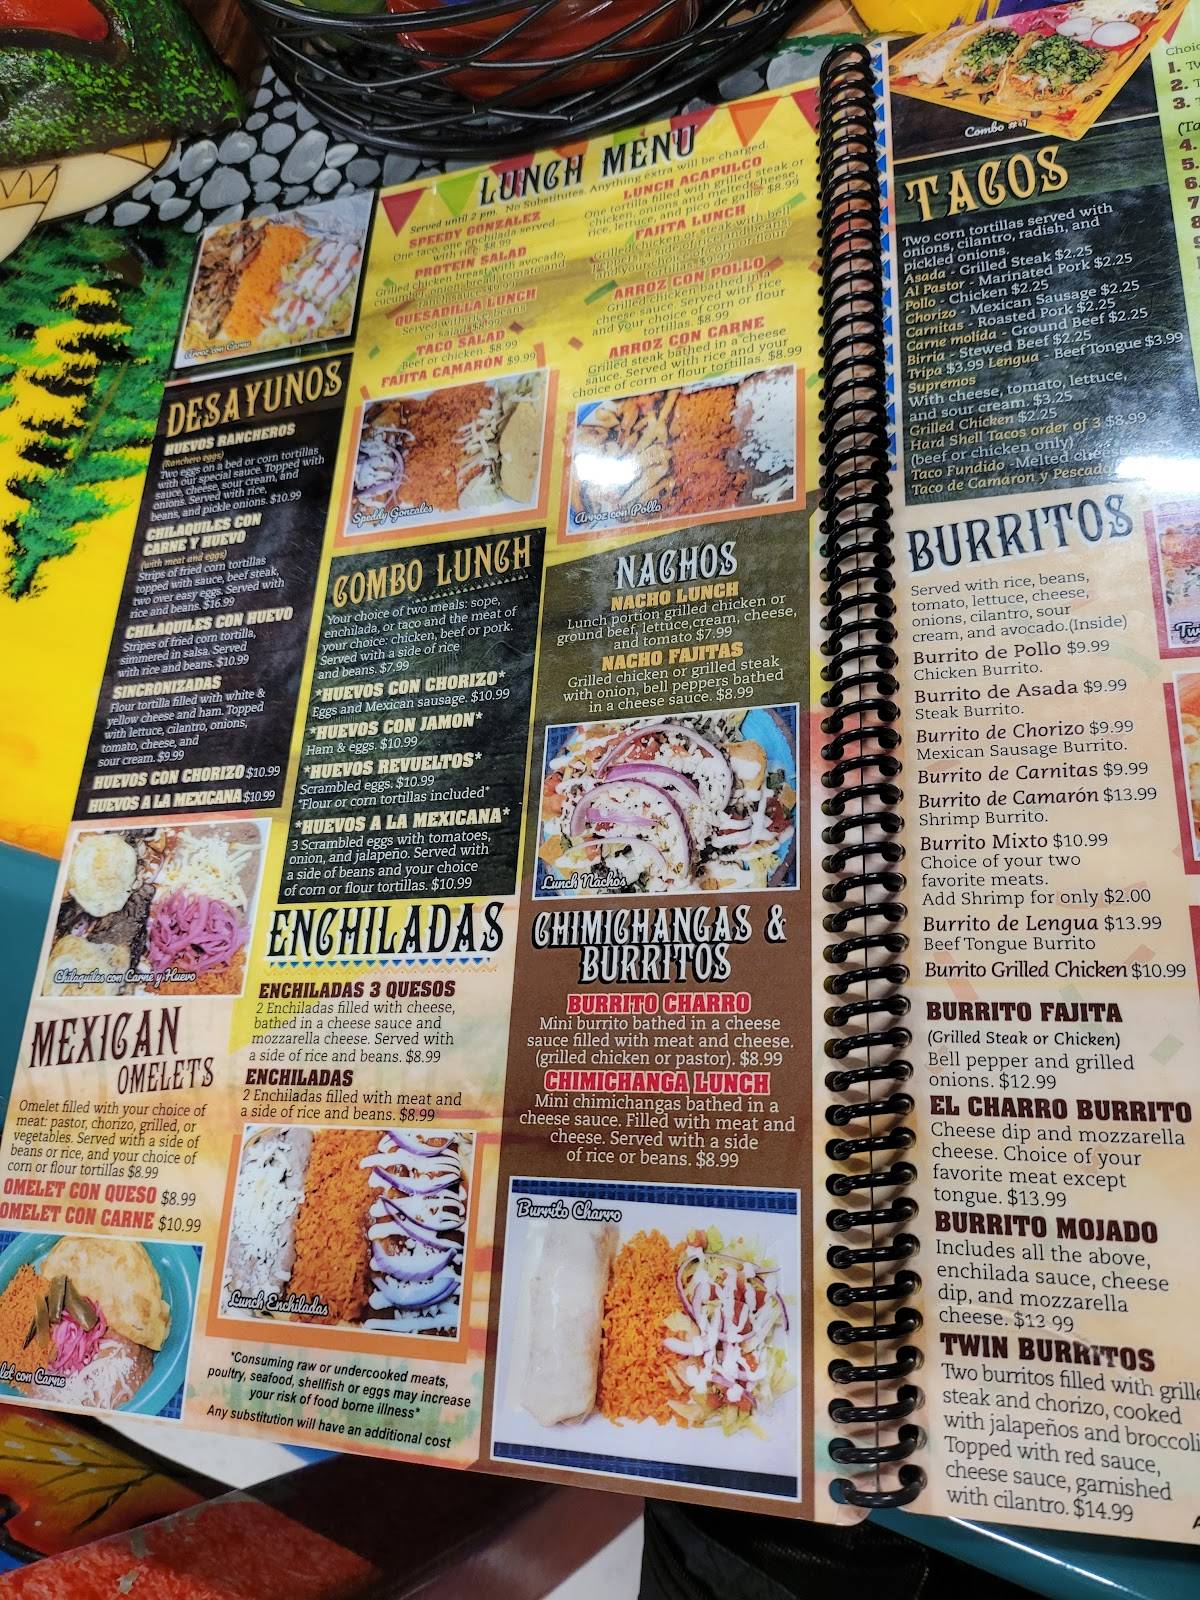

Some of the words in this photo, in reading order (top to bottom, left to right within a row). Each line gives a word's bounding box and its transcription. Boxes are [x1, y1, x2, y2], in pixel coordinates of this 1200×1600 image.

[480, 155, 584, 206] LUNCH
[601, 126, 696, 178] MENU
[623, 180, 674, 200] LUNCH
[680, 157, 762, 185] ACAPULCO
[905, 145, 1069, 222] TACOS
[409, 228, 462, 249] SPEEDY
[466, 211, 541, 236] GONZALEZ
[415, 258, 475, 279] PROTEIN
[480, 246, 527, 265] SALAD
[904, 270, 946, 285] Asada
[960, 260, 1008, 275] Grilled
[1011, 253, 1051, 267] Steak
[1055, 246, 1092, 261] $2.25
[395, 300, 482, 327] QUESADILLA
[487, 288, 537, 307] LUNCH
[416, 339, 452, 355] TACO
[458, 330, 506, 347] SALAD
[608, 339, 663, 359] ARROZ
[669, 330, 701, 347] CON
[707, 317, 765, 338] CARNE
[572, 384, 611, 399] choice
[614, 380, 626, 391] of
[630, 377, 657, 388] corn
[661, 374, 673, 382] or
[678, 366, 706, 379] flour
[768, 346, 802, 361] $8.99
[908, 375, 976, 394] Supremos
[167, 360, 343, 438] DESAYUNOS
[164, 437, 214, 456] HUEVOS
[217, 423, 296, 447] RANCHEROS
[146, 518, 231, 541] CHILAQUILES
[234, 512, 262, 527] CON
[906, 494, 1133, 573] BURRITOS
[332, 559, 423, 608] COMBO
[437, 535, 532, 586] LUNCH
[616, 541, 738, 590] NACHOS
[327, 614, 350, 625] Your
[354, 610, 390, 621] choice
[392, 607, 405, 618] of
[407, 605, 427, 614] two
[430, 600, 468, 612] meals:
[470, 596, 501, 610] sope,
[611, 591, 671, 611] NACHO
[676, 582, 738, 602] LUNCH
[567, 616, 607, 630] Lunch
[612, 610, 660, 625] portion
[665, 605, 707, 622] grilled
[711, 597, 766, 612] chicken
[771, 596, 786, 605] or
[602, 651, 662, 671] NACHO
[668, 641, 744, 664] FAJITAS
[913, 649, 978, 664] Burrito
[985, 645, 1008, 660] de
[1014, 642, 1061, 658] Pollo
[1067, 640, 1110, 655] $9.99
[113, 675, 222, 699] SINCRONIZADAS
[388, 679, 420, 694] CON
[312, 707, 337, 719] Eggs
[341, 703, 361, 715] and
[365, 699, 414, 713] Mexican
[418, 695, 467, 709] sausage.
[471, 689, 510, 703] $10.99
[93, 773, 147, 790] HUEVOS
[150, 769, 179, 785] CON
[182, 765, 245, 783] CHORIZO
[246, 766, 280, 779] $10.99
[919, 794, 981, 809] Burrito
[987, 791, 1007, 806] de
[1013, 788, 1099, 804] Camarón
[1104, 788, 1157, 802] $13.99
[370, 816, 381, 831] A
[386, 813, 407, 830] LA
[541, 872, 578, 890] Lunch
[582, 871, 627, 888] Nachos
[922, 892, 956, 906] Add
[961, 892, 1025, 908] Shrimp
[1030, 890, 1054, 904] for
[1060, 889, 1098, 907] only
[1104, 889, 1151, 904] $2.00
[267, 902, 504, 956] ENCHILADAS
[534, 904, 752, 948] CHIMICHANGAS
[767, 904, 786, 942] &
[580, 943, 730, 983] BURRITOS
[55, 969, 105, 988] Chilaquiles
[106, 974, 122, 983] con
[125, 968, 154, 983] Carne
[155, 974, 164, 987] y
[165, 968, 196, 982] Huevo
[258, 982, 365, 999] ENCHILADAS
[370, 982, 380, 998] 3
[386, 980, 456, 998] QUESOS
[567, 993, 658, 1014] BURRITO
[663, 992, 751, 1013] CHARRO
[927, 1002, 1031, 1022] BURRITO
[1040, 1002, 1123, 1022] FAJITA
[29, 1006, 183, 1068] MEXICAN
[254, 1017, 296, 1030] bathed
[300, 1017, 312, 1029] in
[317, 1019, 323, 1029] a
[327, 1017, 371, 1029] cheese
[374, 1019, 412, 1029] sauce
[417, 1016, 441, 1029] and
[536, 1050, 586, 1067] (grilled
[591, 1050, 650, 1066] chicken
[656, 1053, 670, 1065] or
[676, 1052, 736, 1069] pastor).
[740, 1051, 782, 1066] $8.99
[118, 1057, 214, 1094] OMELETS
[544, 1070, 688, 1092] CHIMICHANGA
[694, 1072, 770, 1095] LUNCH
[930, 1095, 959, 1116] EL
[967, 1097, 1068, 1119] CHARRO
[1077, 1099, 1192, 1123] BURRITO
[50, 1119, 87, 1131] pastor,
[91, 1119, 136, 1133] chorizo,
[139, 1119, 179, 1136] grilled,
[183, 1122, 196, 1132] or
[4, 1178, 65, 1197] OMELET
[70, 1182, 101, 1200] CON
[105, 1185, 157, 1204] QUESO
[161, 1190, 196, 1207] $8.99
[517, 1198, 569, 1219] Burrito
[572, 1200, 622, 1222] Charro
[228, 1290, 264, 1310] Lunch
[266, 1293, 328, 1315] Enchiladas
[940, 1333, 1008, 1359] TWIN
[1018, 1337, 1155, 1372] BURRITOS
[297, 1361, 316, 1371] raw
[320, 1364, 332, 1372] or
[334, 1365, 408, 1382] undercooked
[410, 1373, 449, 1389] meats,
[207, 1404, 228, 1419] Any
[231, 1410, 294, 1428] substitution
[297, 1416, 316, 1430] will
[319, 1419, 344, 1434] have
[348, 1425, 361, 1436] an
[364, 1426, 421, 1445] additional
[425, 1436, 452, 1448] cost
[946, 1488, 988, 1508] with
[994, 1491, 1068, 1515] cilantro.
[1073, 1499, 1134, 1522] $14.99
